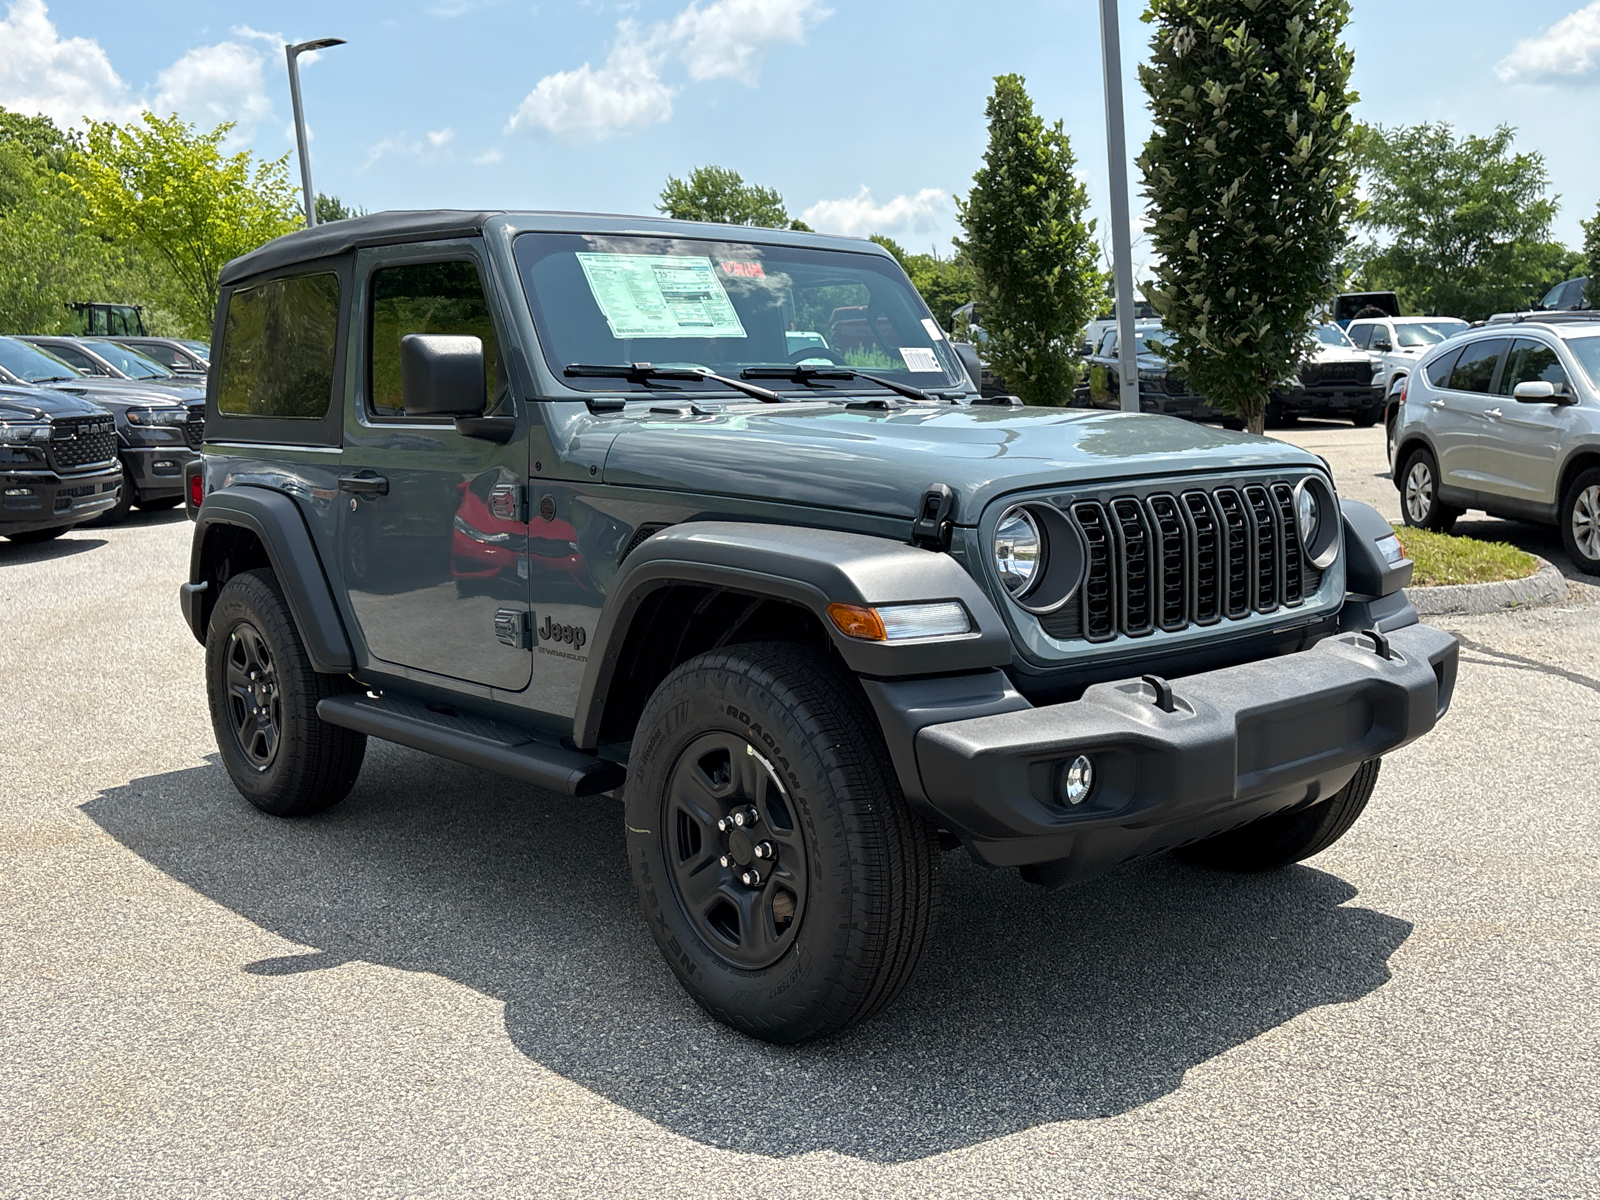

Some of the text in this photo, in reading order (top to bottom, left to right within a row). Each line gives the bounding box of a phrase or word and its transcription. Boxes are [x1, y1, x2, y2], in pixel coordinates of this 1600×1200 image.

[77, 422, 109, 434] RAM
[538, 615, 586, 650] Jeep
[545, 648, 588, 662] WRANGLER
[637, 727, 662, 784] All-Weather
[726, 704, 801, 790] ROADIAN
[638, 861, 698, 976] NEXEN
[769, 961, 803, 1000] 245/75R17
